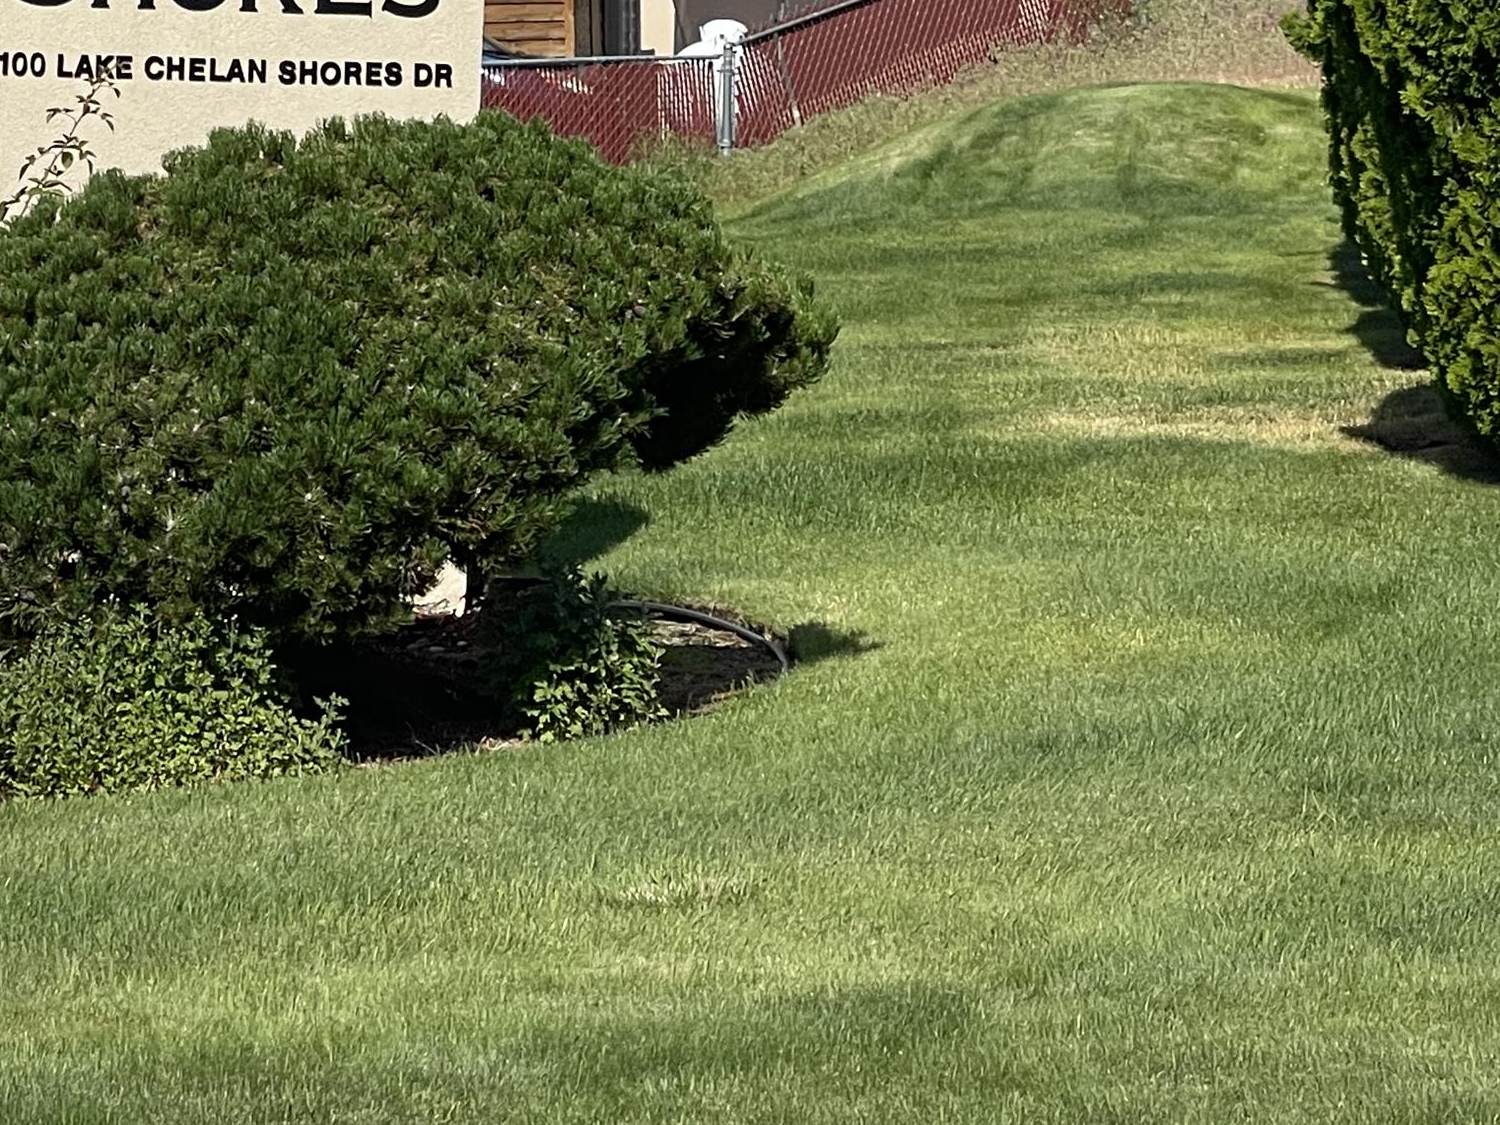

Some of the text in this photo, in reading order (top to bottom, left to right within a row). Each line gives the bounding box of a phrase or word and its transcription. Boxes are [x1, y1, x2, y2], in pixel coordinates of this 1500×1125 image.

[57, 53, 133, 81] LAKE
[144, 55, 267, 84] CHELAN
[277, 60, 403, 87] SHORES
[414, 62, 453, 88] DR
